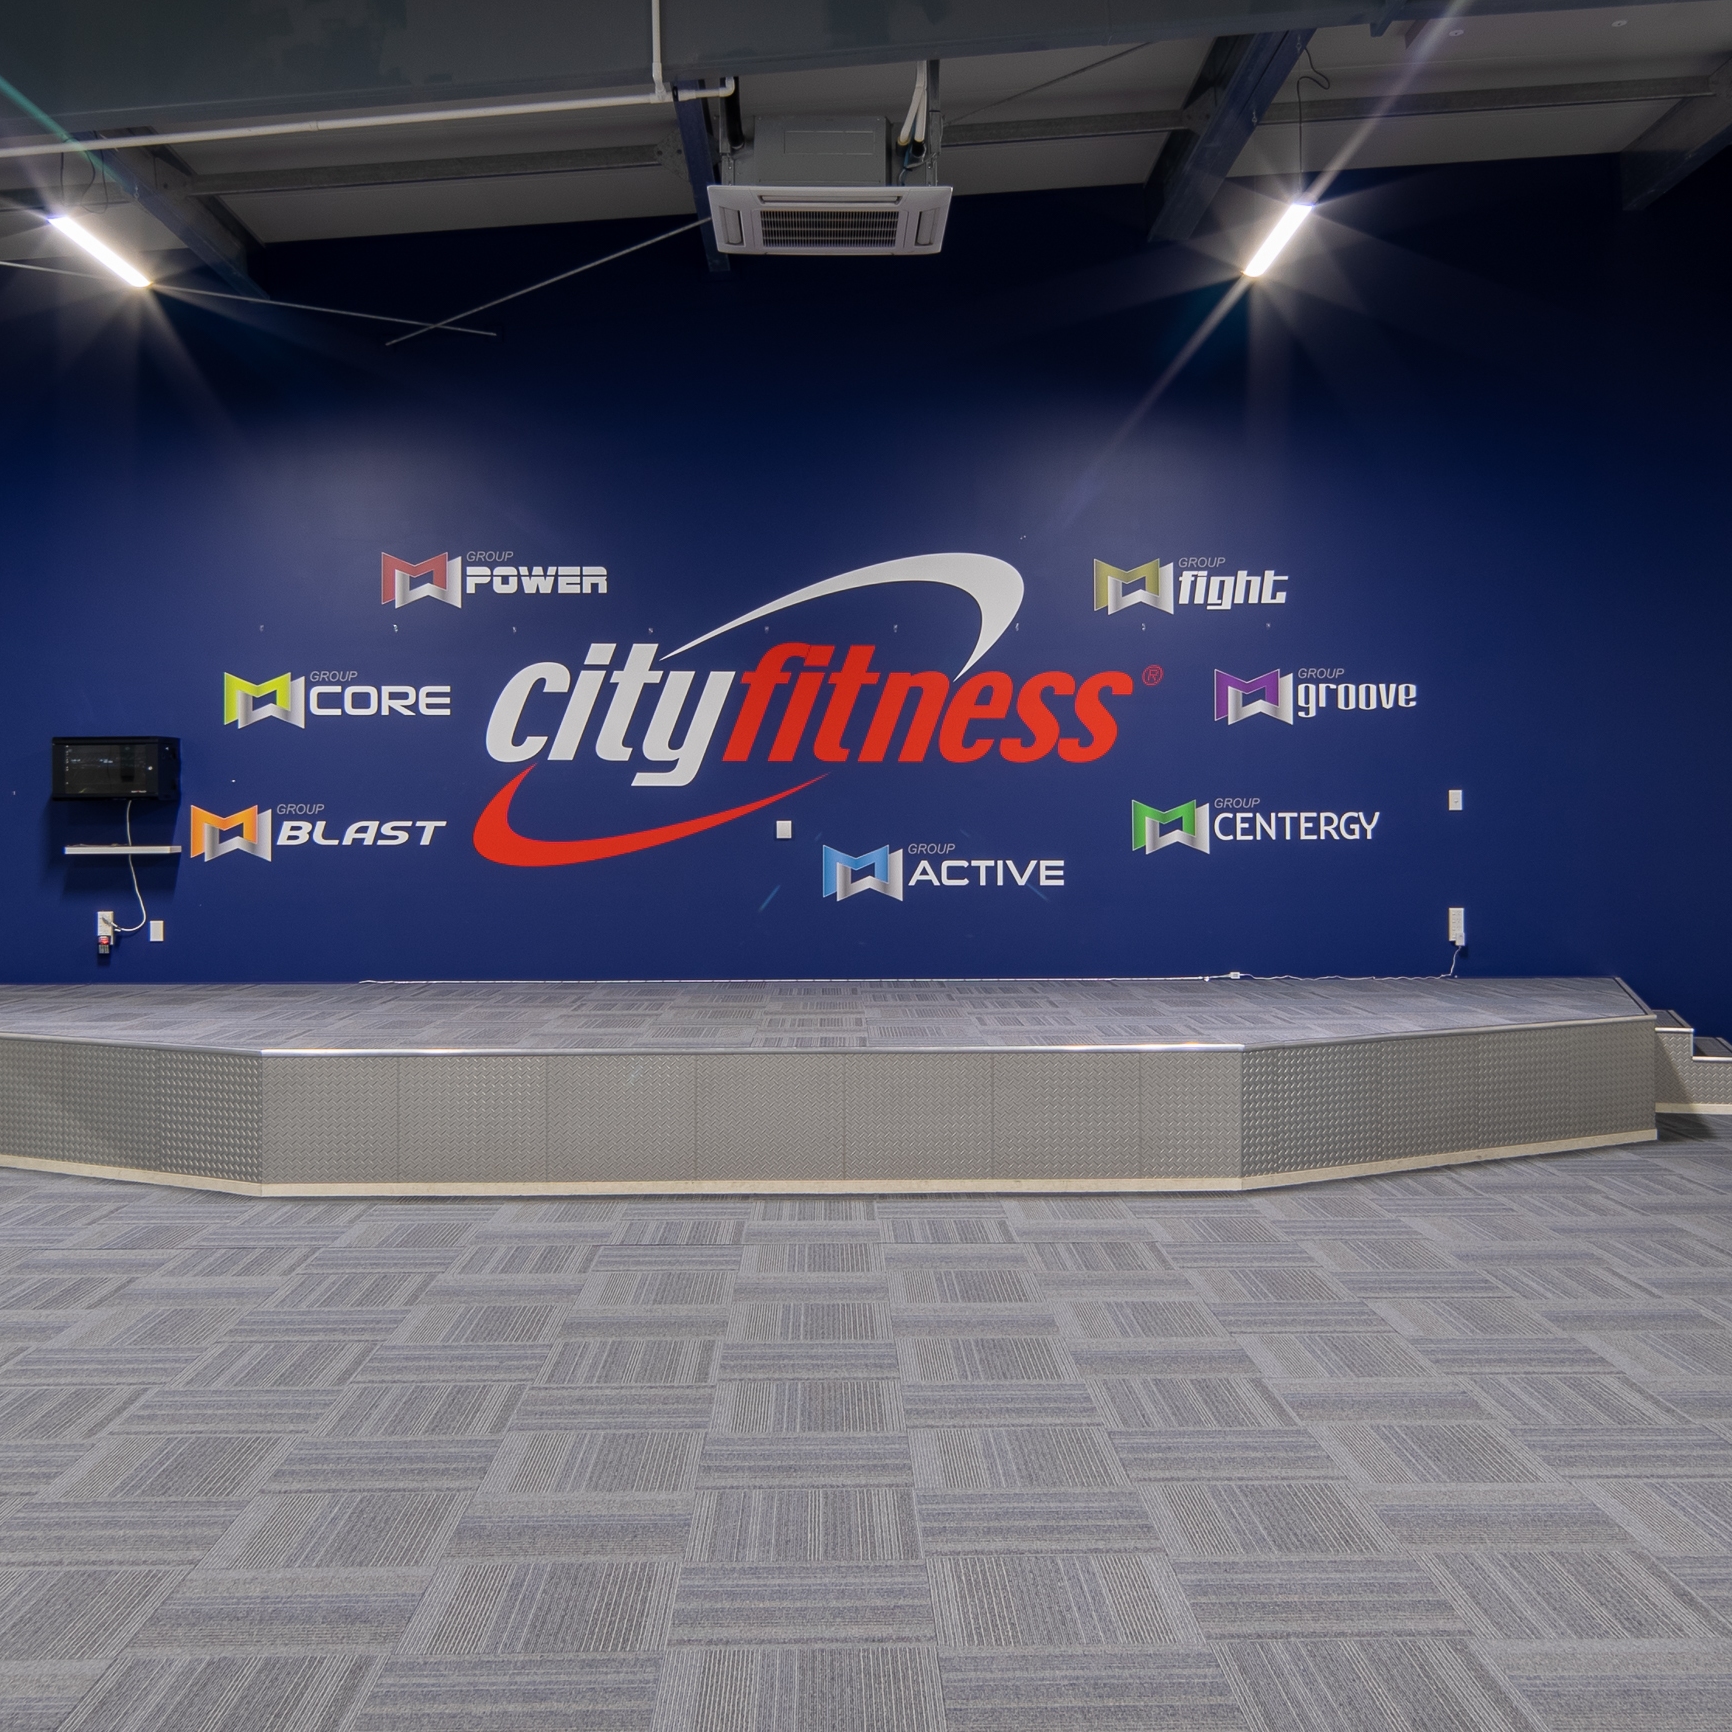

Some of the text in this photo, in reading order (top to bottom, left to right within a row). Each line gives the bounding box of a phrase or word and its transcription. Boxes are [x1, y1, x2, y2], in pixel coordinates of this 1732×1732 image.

[465, 550, 514, 562] GROUP
[1177, 556, 1226, 569] GROUP
[465, 565, 608, 595] POWER
[1177, 569, 1289, 610] fight
[309, 670, 358, 682] GROUP
[1296, 667, 1345, 679] GROUP
[308, 684, 452, 717] CORE
[1296, 679, 1417, 718] groove
[485, 641, 1134, 787] cityfitness
[276, 803, 325, 815] GROUP
[1213, 796, 1261, 809] GROUP
[276, 820, 447, 846] BLAST
[1213, 810, 1380, 843] CENTERGY
[907, 842, 956, 855] GROUP
[907, 859, 1066, 887] ACTIVE
